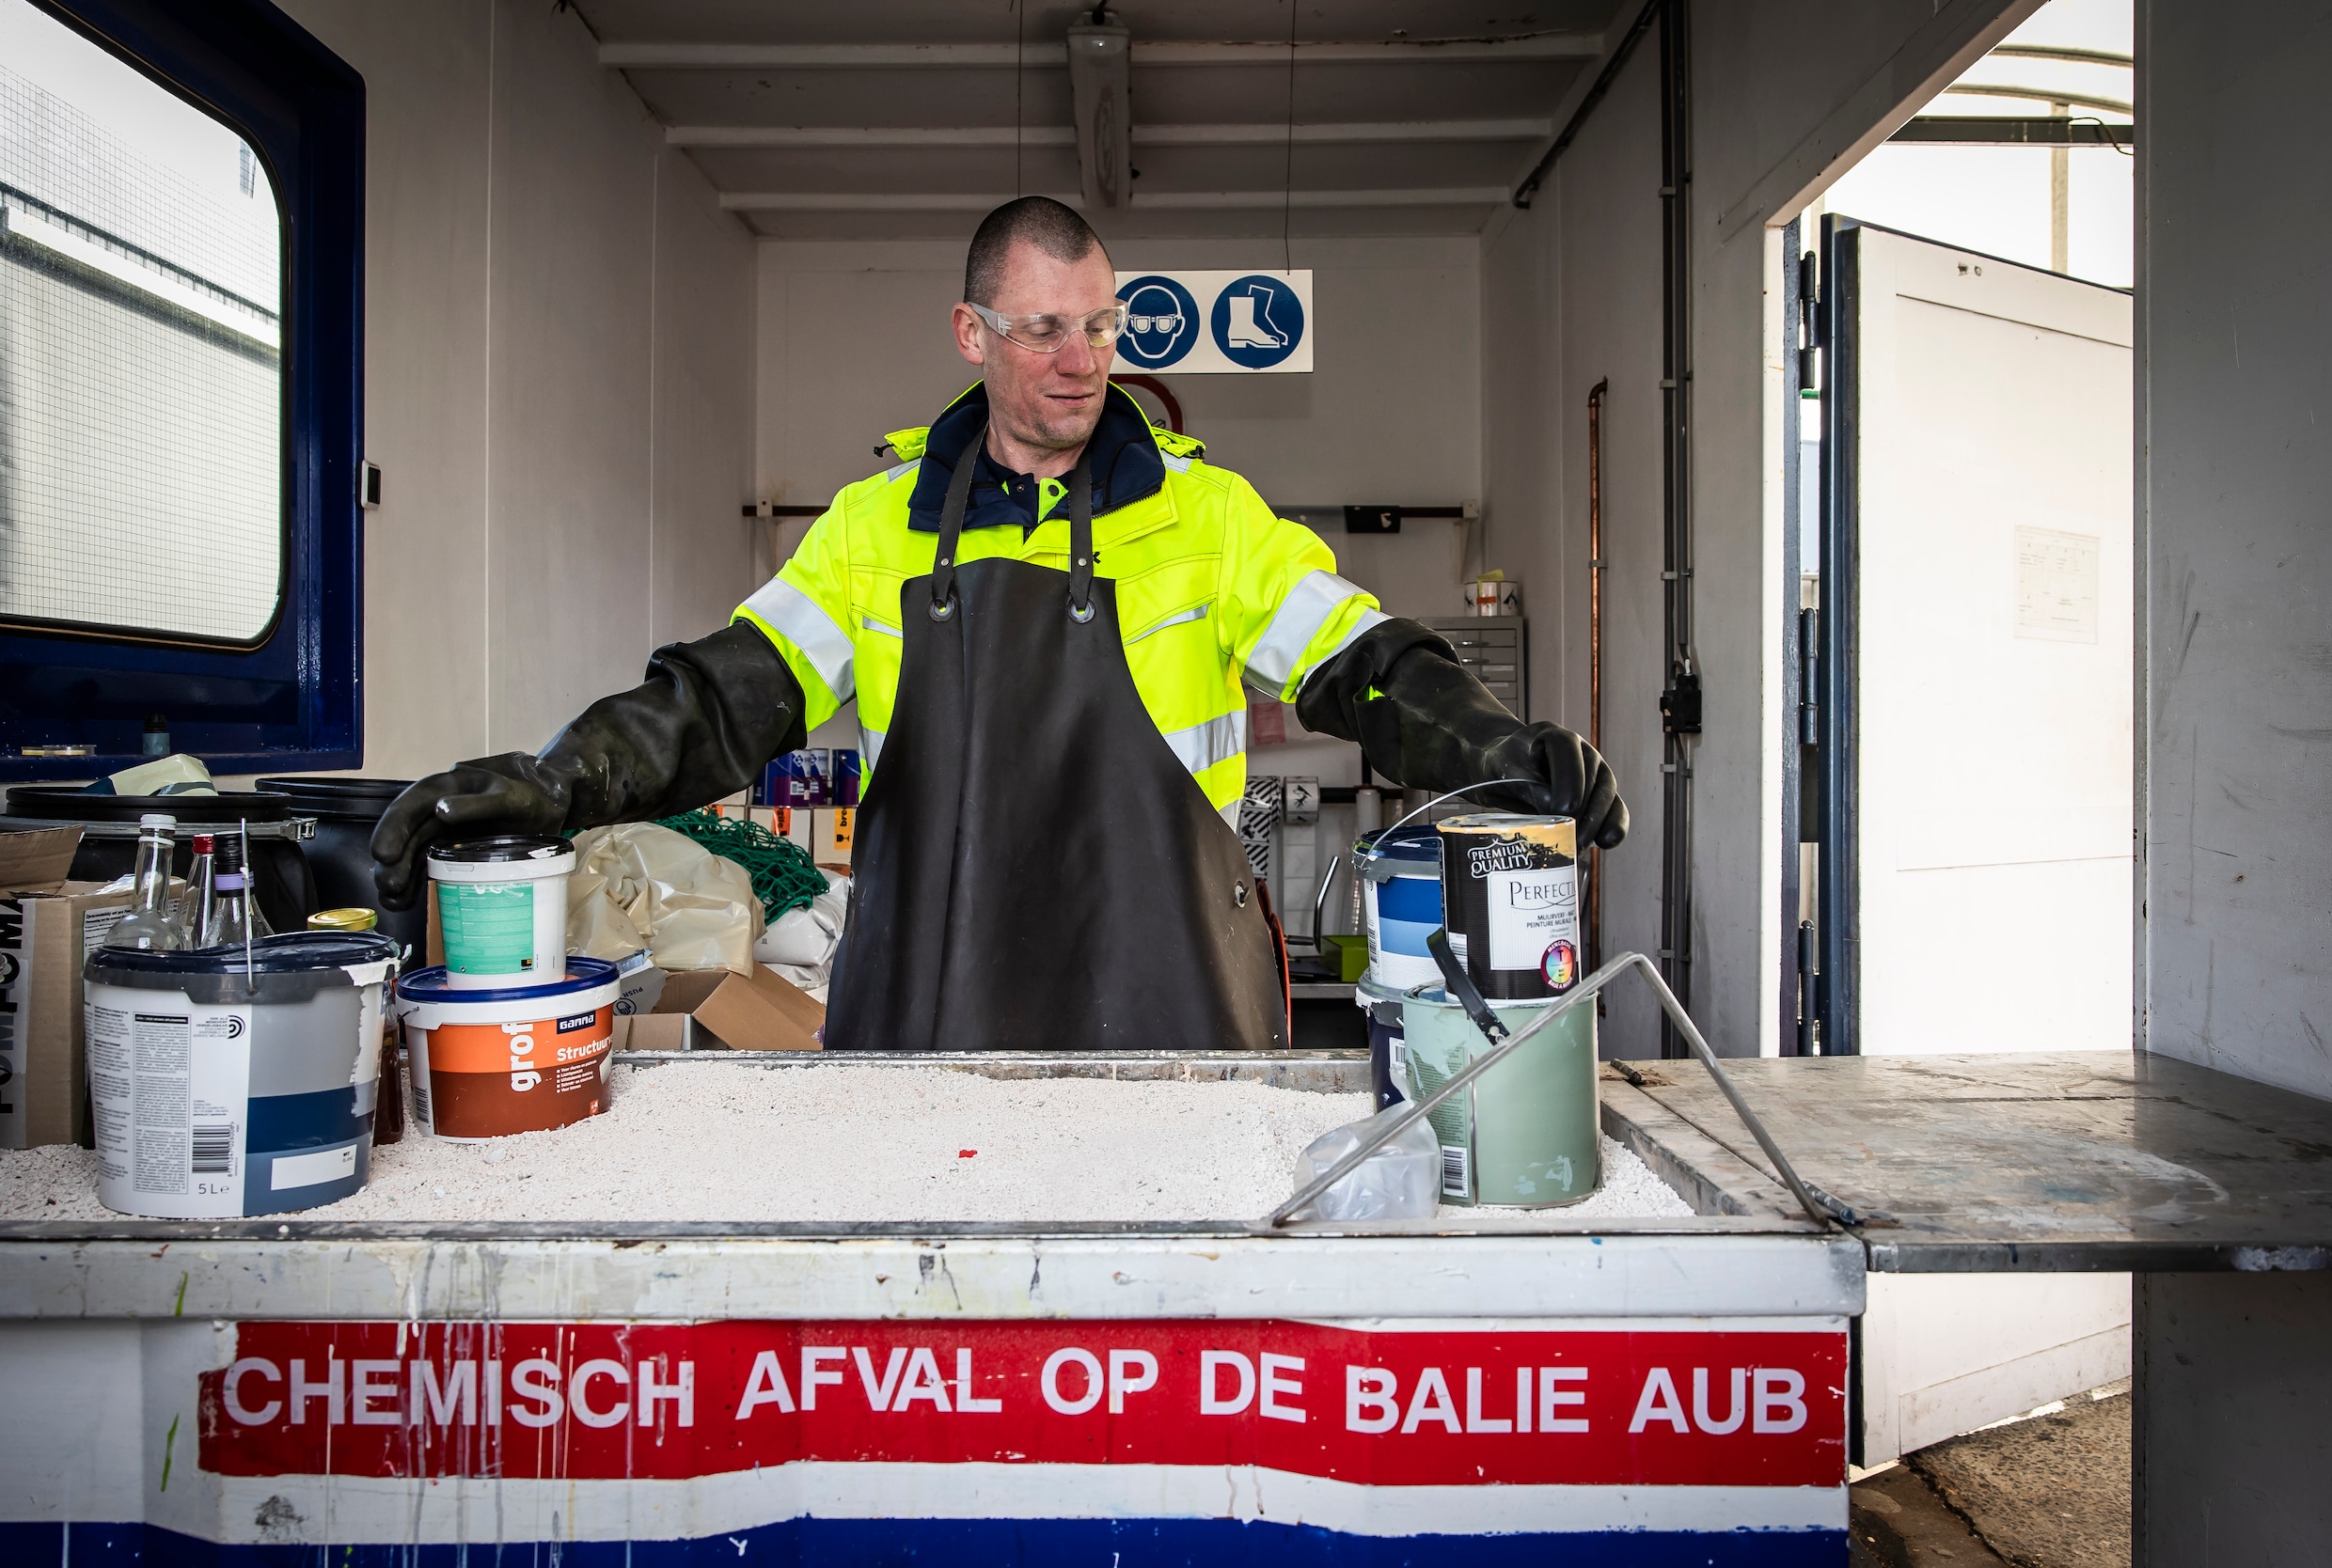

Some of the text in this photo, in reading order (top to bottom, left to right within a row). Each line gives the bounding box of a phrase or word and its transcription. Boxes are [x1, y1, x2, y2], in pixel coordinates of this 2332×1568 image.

[1472, 844, 1526, 861] PREMIUM
[1472, 854, 1530, 874] QUALITY
[1509, 880, 1577, 906] PERFECTI
[1526, 919, 1553, 929] PEINTURE
[1557, 949, 1564, 962] T
[622, 987, 643, 997] PUSH
[198, 1184, 207, 1195] 5
[211, 1184, 218, 1195] L
[222, 1346, 1808, 1435] CHEMISCH AFVAL OP DE BALIE AUB
